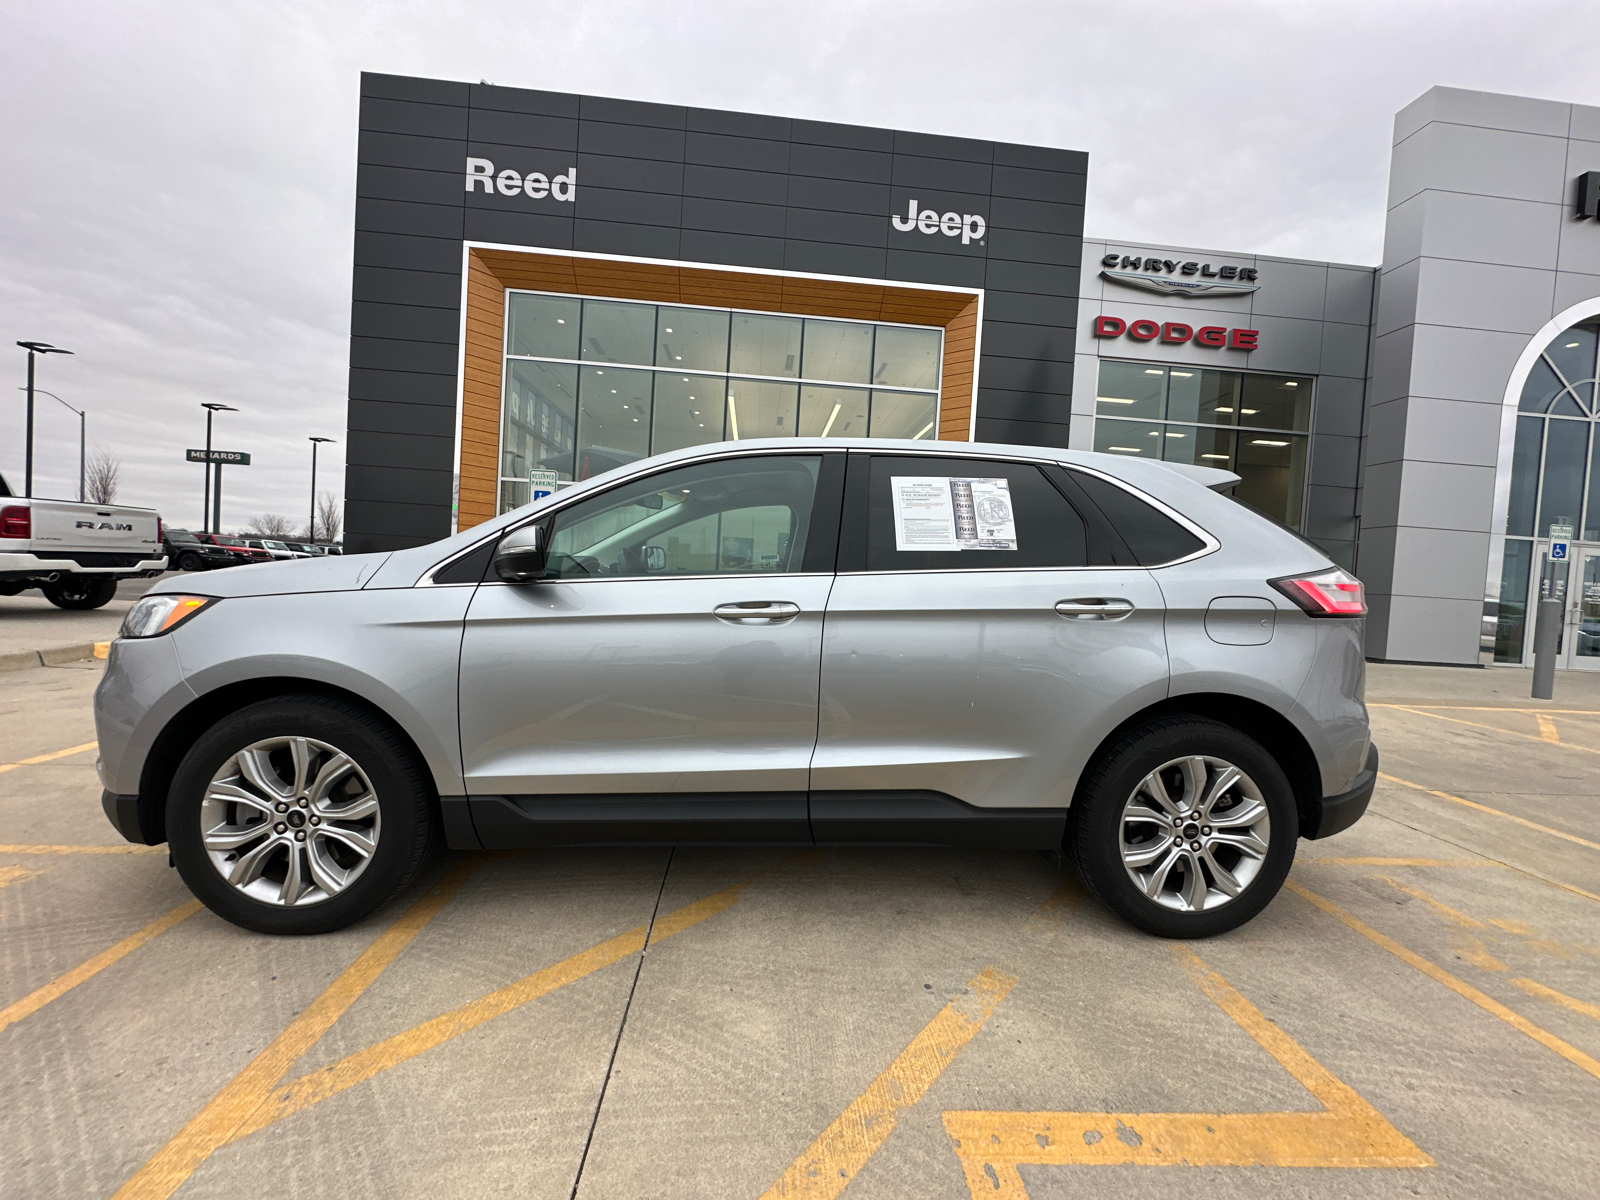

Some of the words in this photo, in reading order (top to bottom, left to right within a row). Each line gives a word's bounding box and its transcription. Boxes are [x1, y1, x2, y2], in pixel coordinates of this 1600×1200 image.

[465, 157, 577, 202] Reed
[892, 199, 986, 245] Jeep
[1102, 253, 1258, 280] CHRYSLER
[1094, 315, 1259, 350] DODGE
[75, 520, 133, 531] RAM
